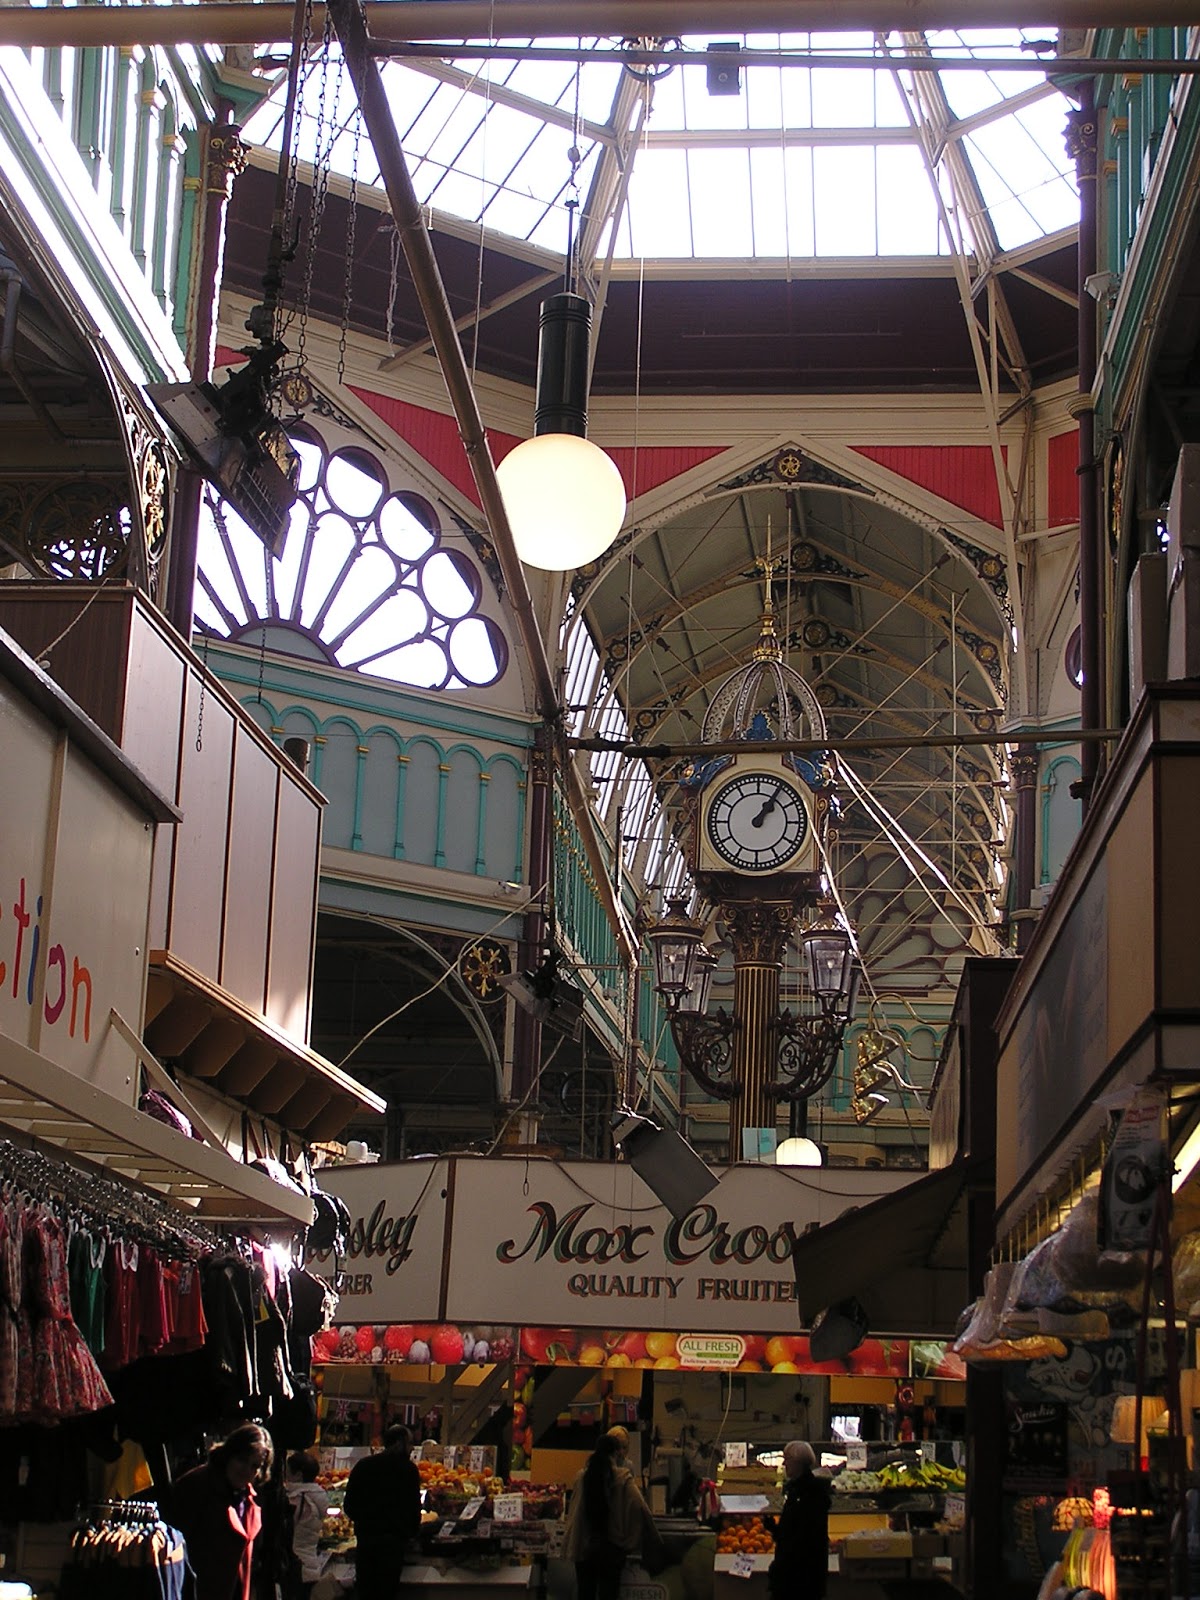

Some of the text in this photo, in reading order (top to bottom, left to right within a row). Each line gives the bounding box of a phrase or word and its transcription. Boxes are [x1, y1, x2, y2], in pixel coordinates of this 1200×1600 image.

[0, 878, 92, 1043] tion
[305, 1199, 419, 1277] sley
[496, 1201, 822, 1266] Max Cros
[567, 1273, 684, 1299] QUALITY
[683, 1341, 739, 1351] ALL FRESH
